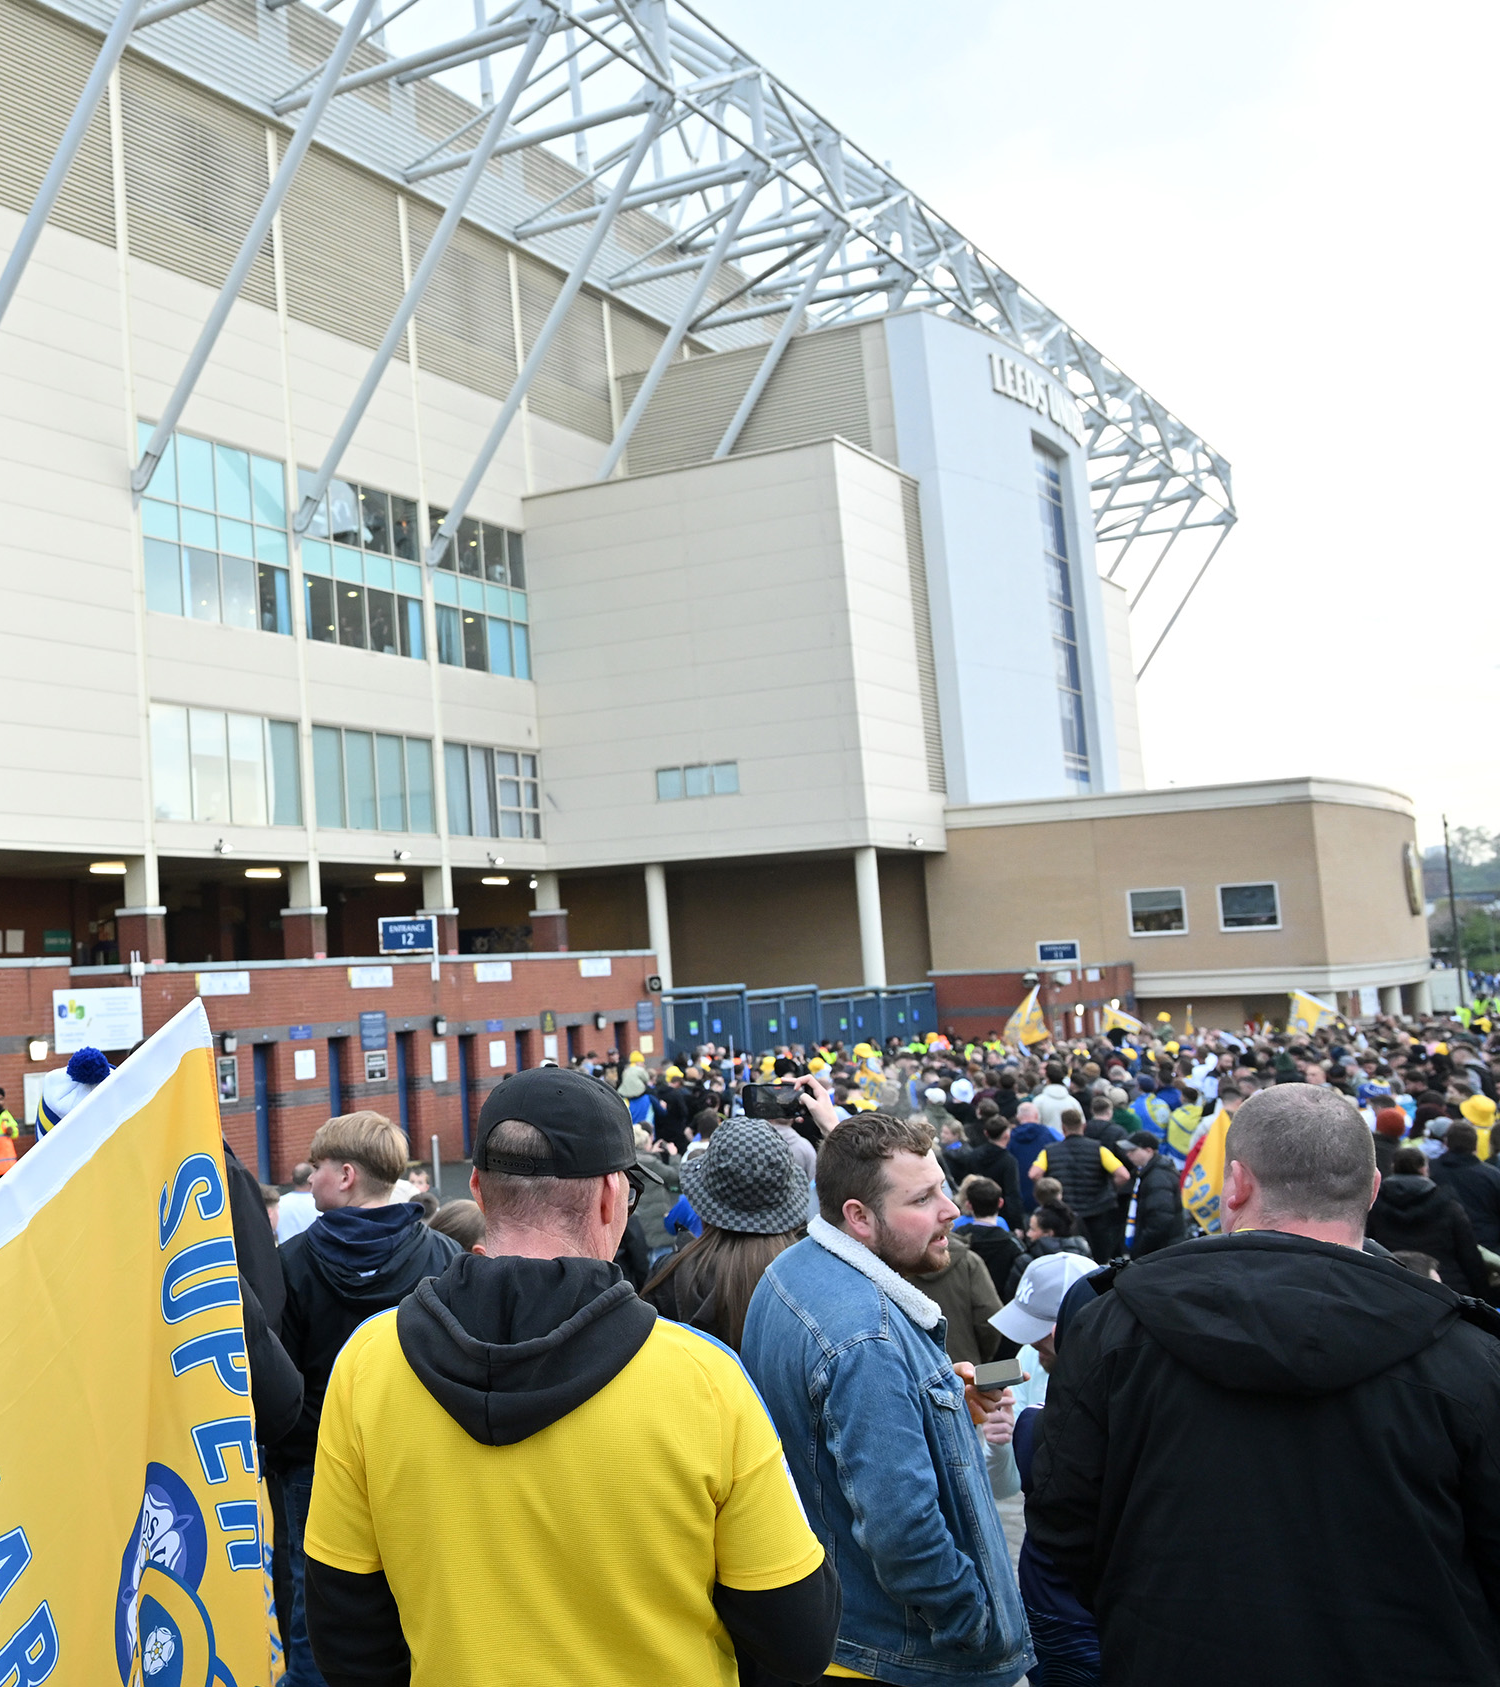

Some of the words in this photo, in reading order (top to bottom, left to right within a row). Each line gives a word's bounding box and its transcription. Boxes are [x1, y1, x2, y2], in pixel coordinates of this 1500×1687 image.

[990, 352, 1049, 416] LEEDS
[388, 923, 426, 934] ENTRANCE
[401, 932, 415, 946] 12
